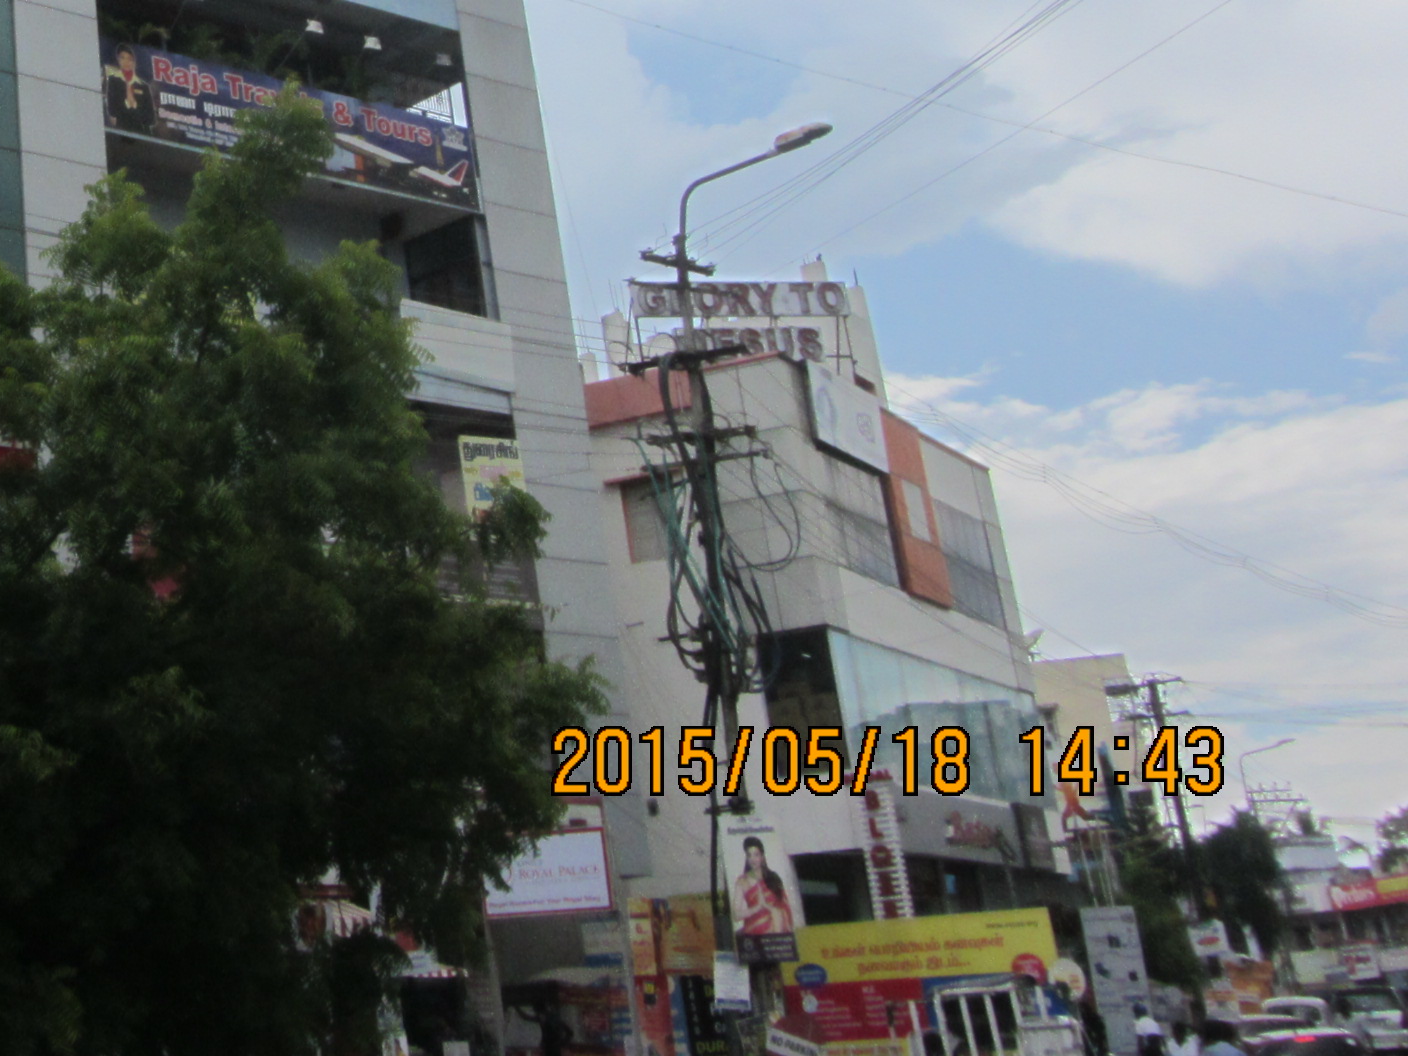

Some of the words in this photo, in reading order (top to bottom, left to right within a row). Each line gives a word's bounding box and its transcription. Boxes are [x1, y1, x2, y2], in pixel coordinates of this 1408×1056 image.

[151, 55, 218, 96] Raja
[333, 100, 353, 127] &
[360, 106, 433, 147] Tours
[789, 282, 845, 315] TO
